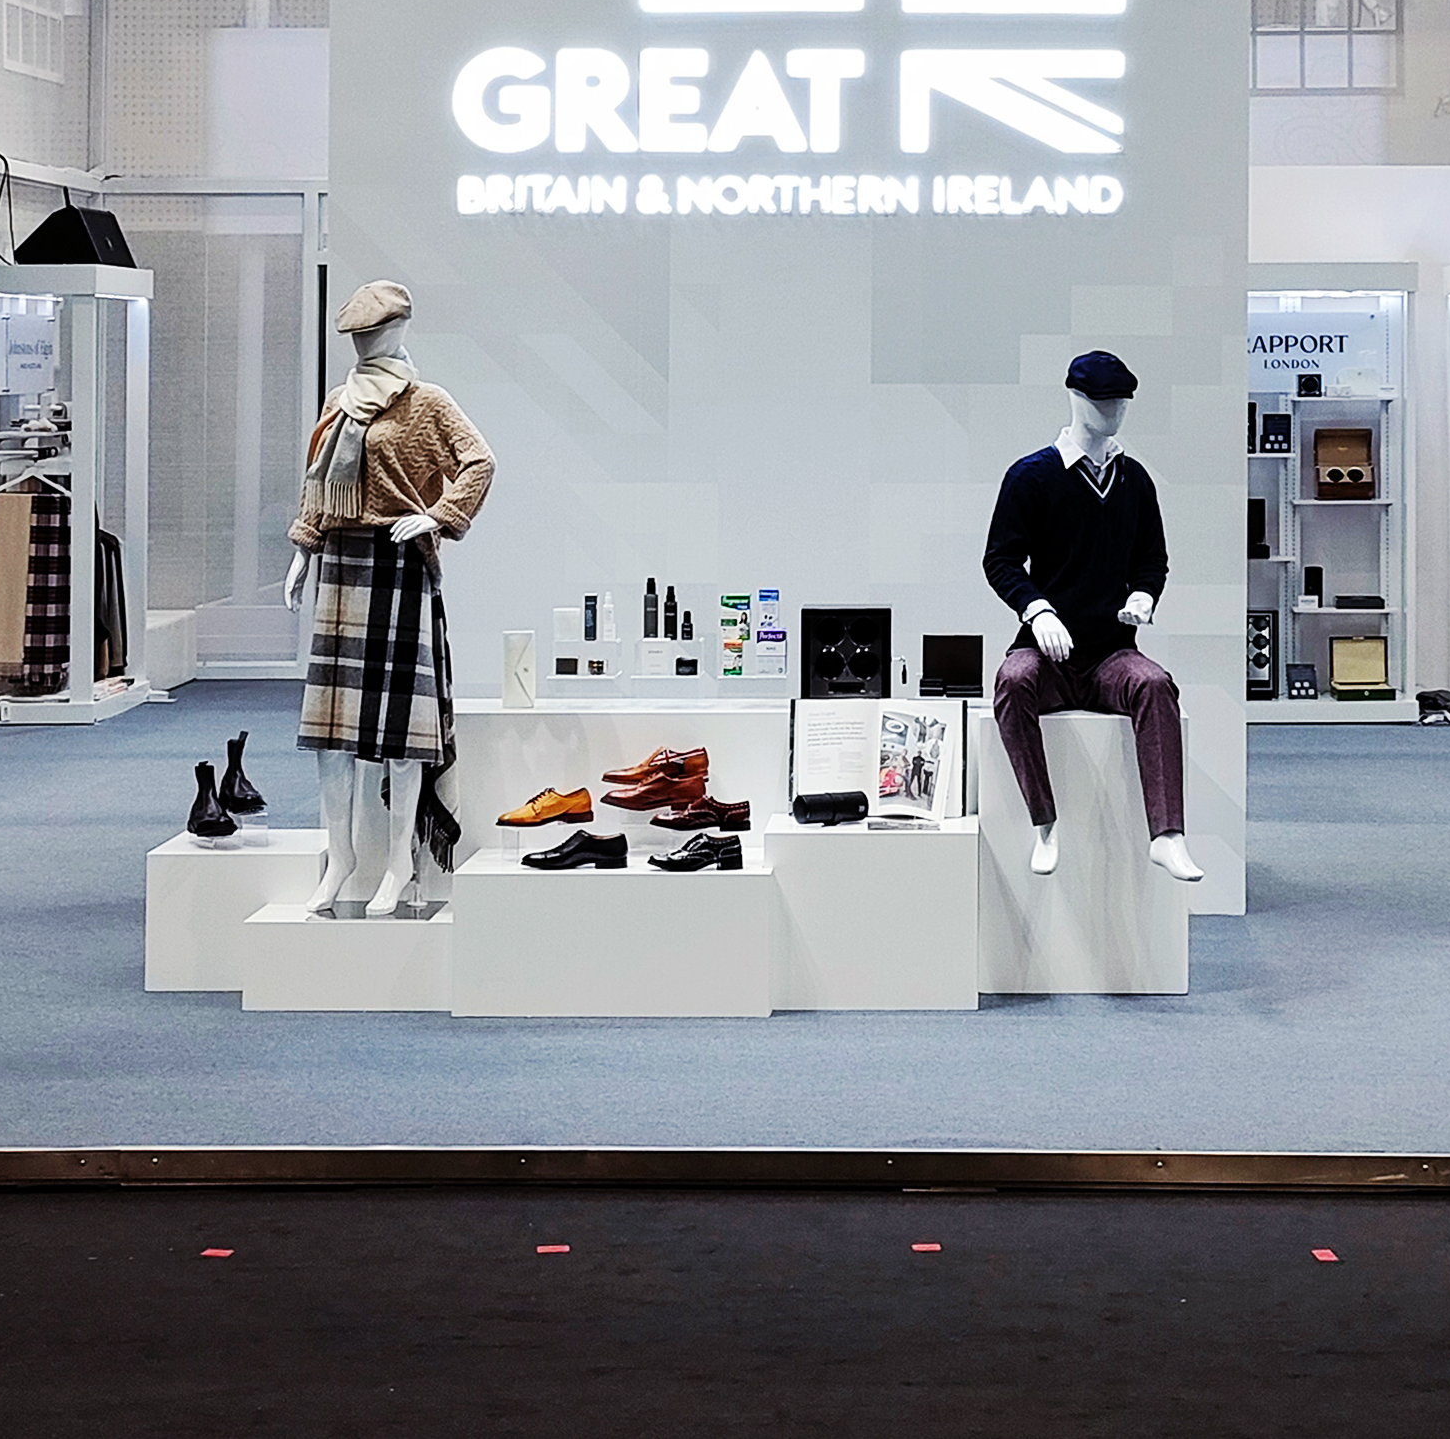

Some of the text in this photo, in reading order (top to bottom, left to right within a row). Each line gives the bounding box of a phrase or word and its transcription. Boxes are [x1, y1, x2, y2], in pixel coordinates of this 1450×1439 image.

[452, 46, 865, 154] GREAT
[456, 174, 1124, 215] BRITAIN & NORTHERN IRELAND
[1247, 335, 1349, 354] APPORT
[1263, 359, 1320, 369] LONDON
